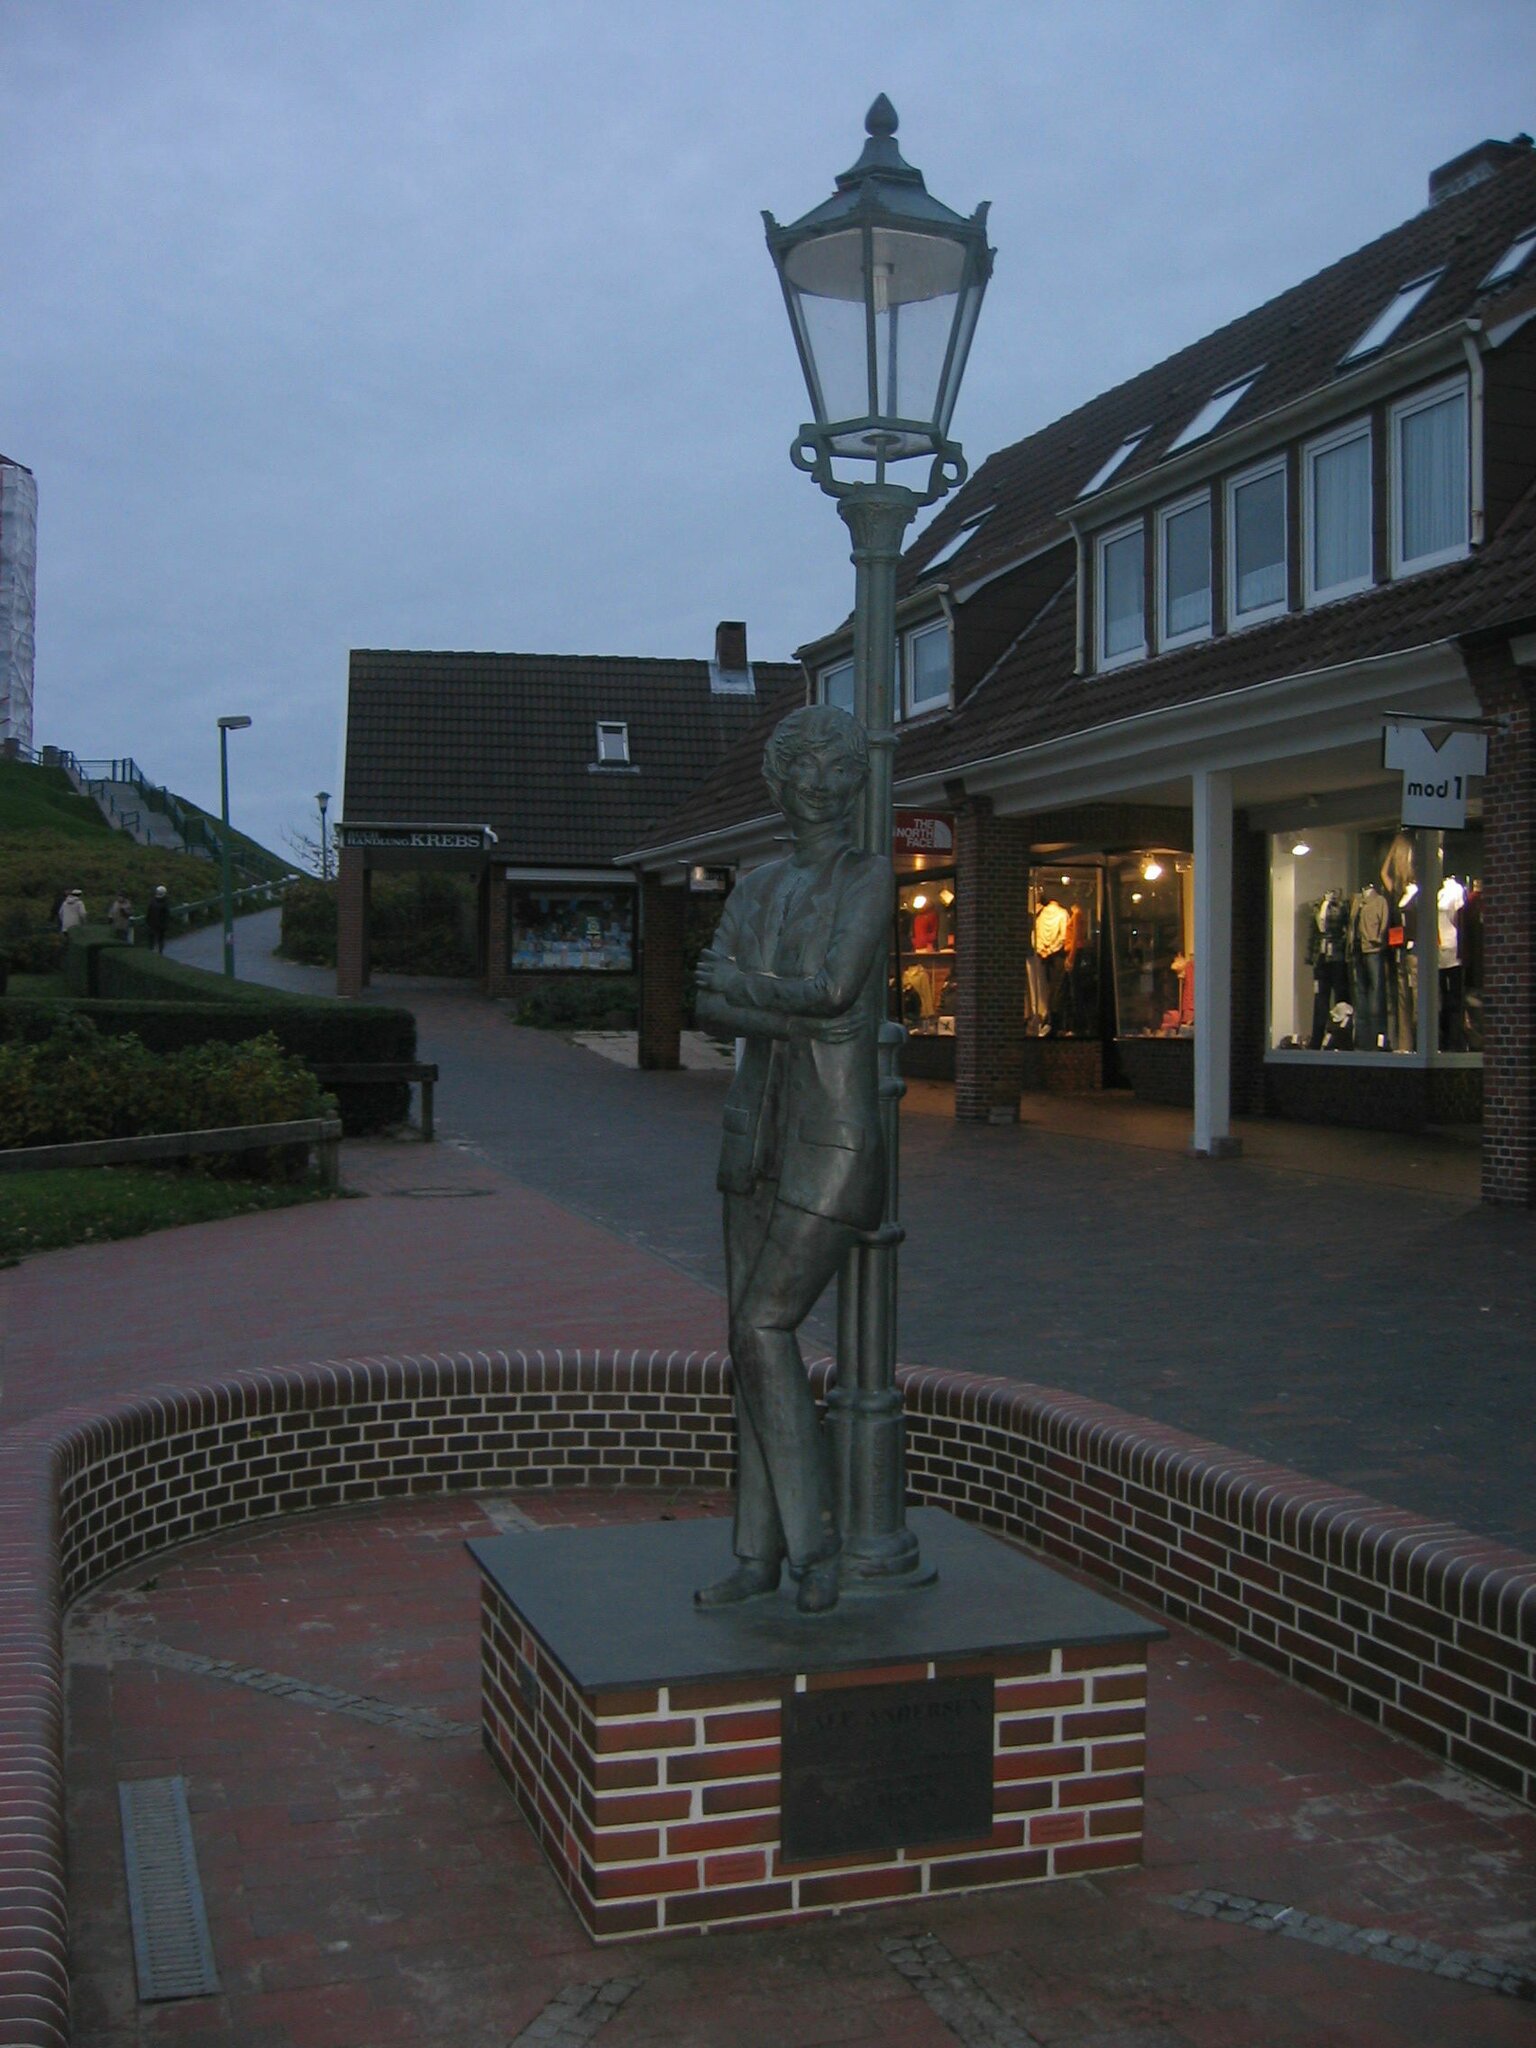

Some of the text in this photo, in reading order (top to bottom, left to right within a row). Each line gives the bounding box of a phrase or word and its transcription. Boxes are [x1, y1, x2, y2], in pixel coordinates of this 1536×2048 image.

[1407, 776, 1463, 800] mod 1
[913, 818, 935, 828] THE
[896, 827, 933, 838] NORTH
[410, 832, 481, 848] KREBS
[906, 838, 933, 848] FACE
